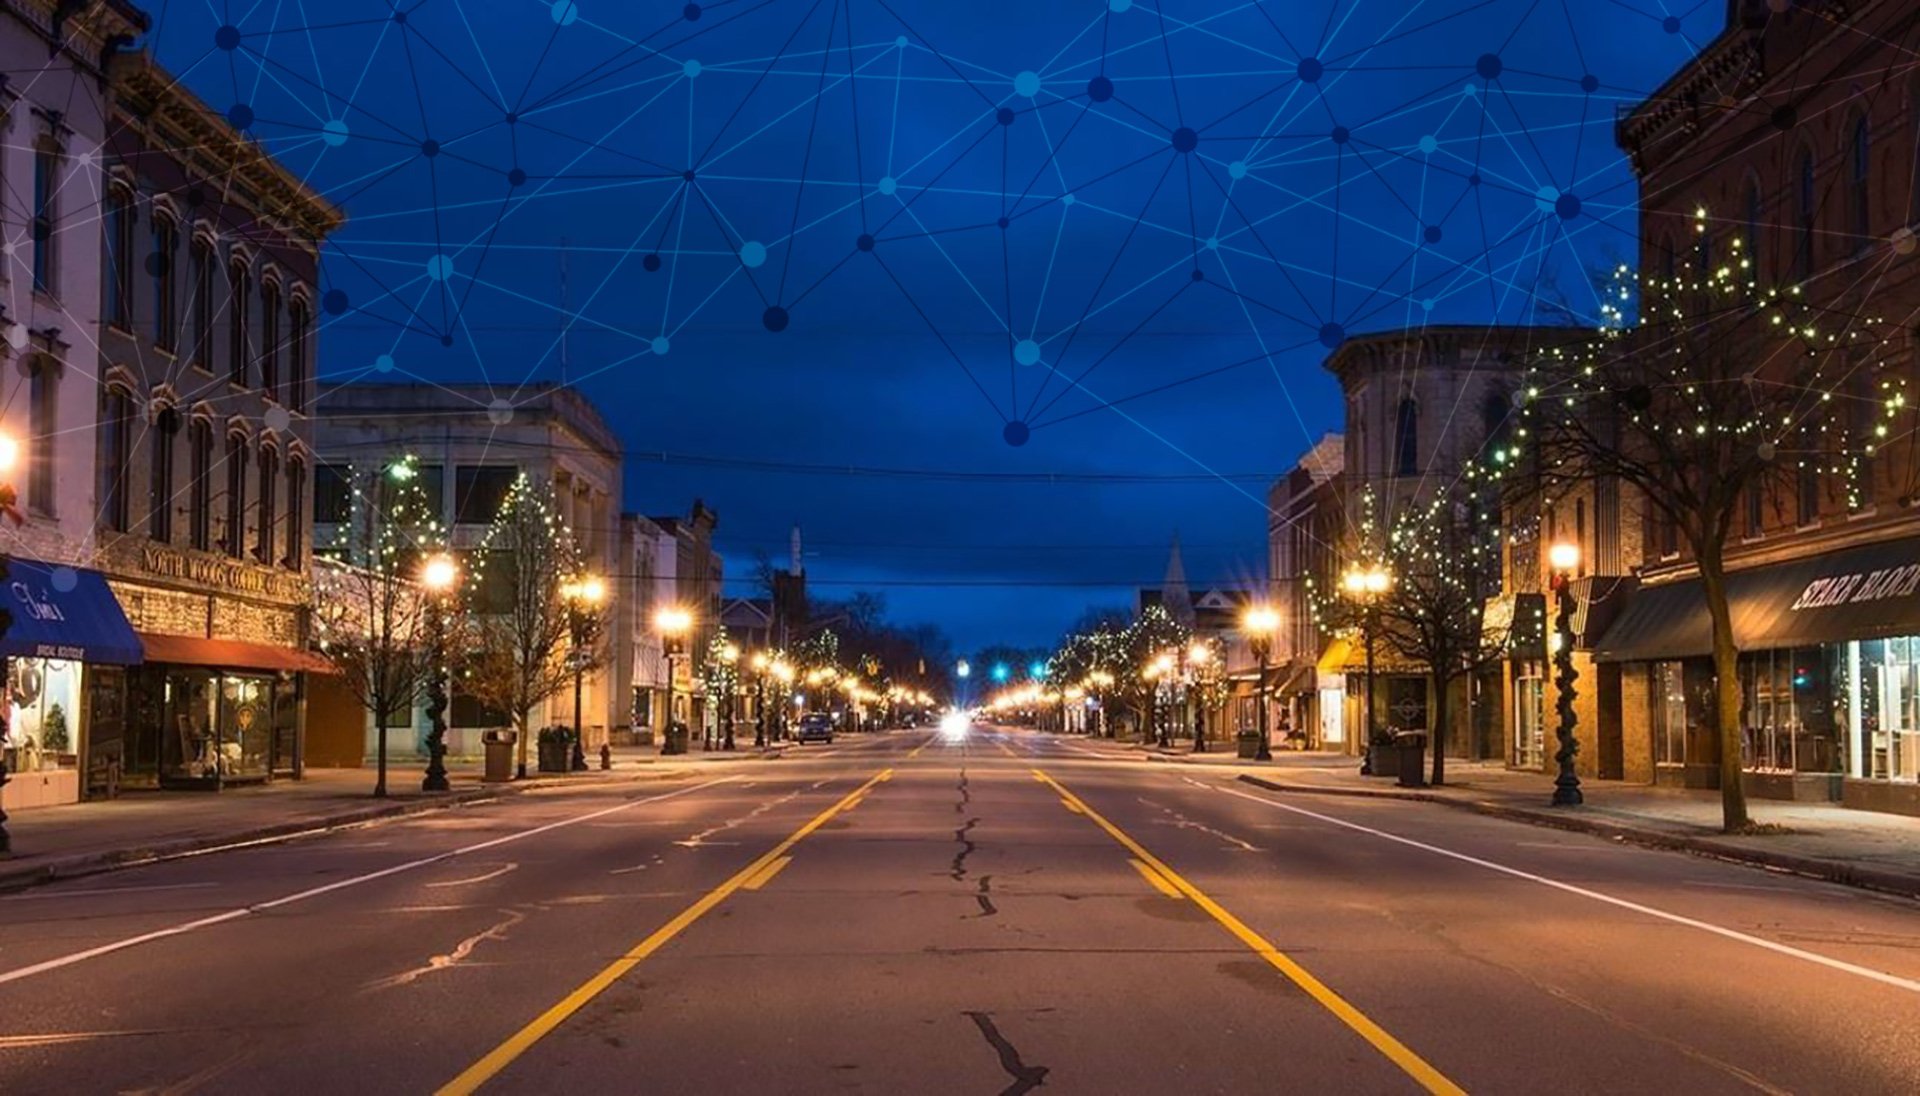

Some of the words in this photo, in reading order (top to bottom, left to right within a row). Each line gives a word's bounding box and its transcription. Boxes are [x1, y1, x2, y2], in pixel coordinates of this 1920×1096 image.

[143, 548, 184, 578] NORTH
[188, 557, 226, 585] WOODS
[1790, 573, 1862, 611] STARR
